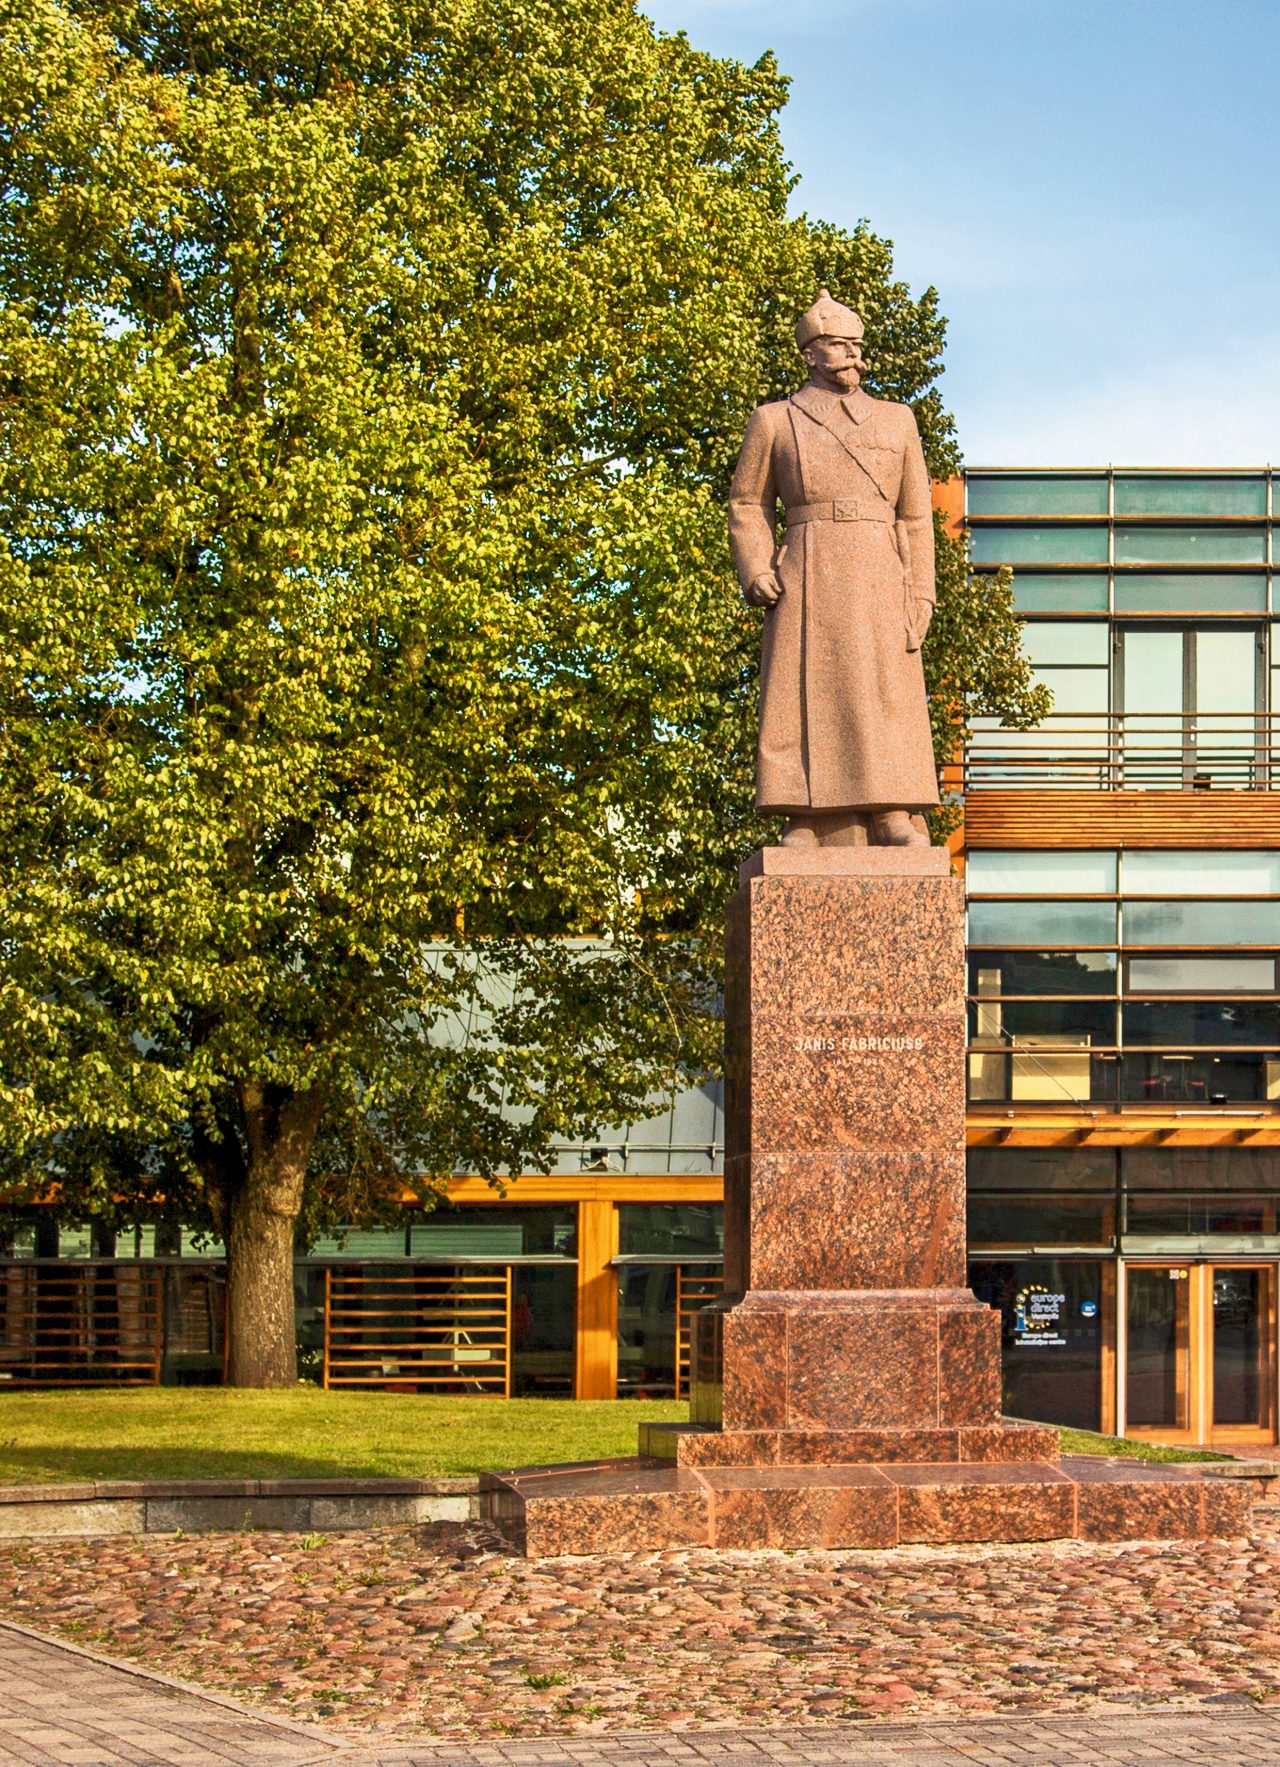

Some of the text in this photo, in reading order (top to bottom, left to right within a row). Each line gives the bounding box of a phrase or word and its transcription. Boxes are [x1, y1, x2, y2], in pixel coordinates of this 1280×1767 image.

[841, 1037, 923, 1051] FABRICIUSS
[1031, 1294, 1065, 1304] europe
[1031, 1302, 1059, 1312] direct
